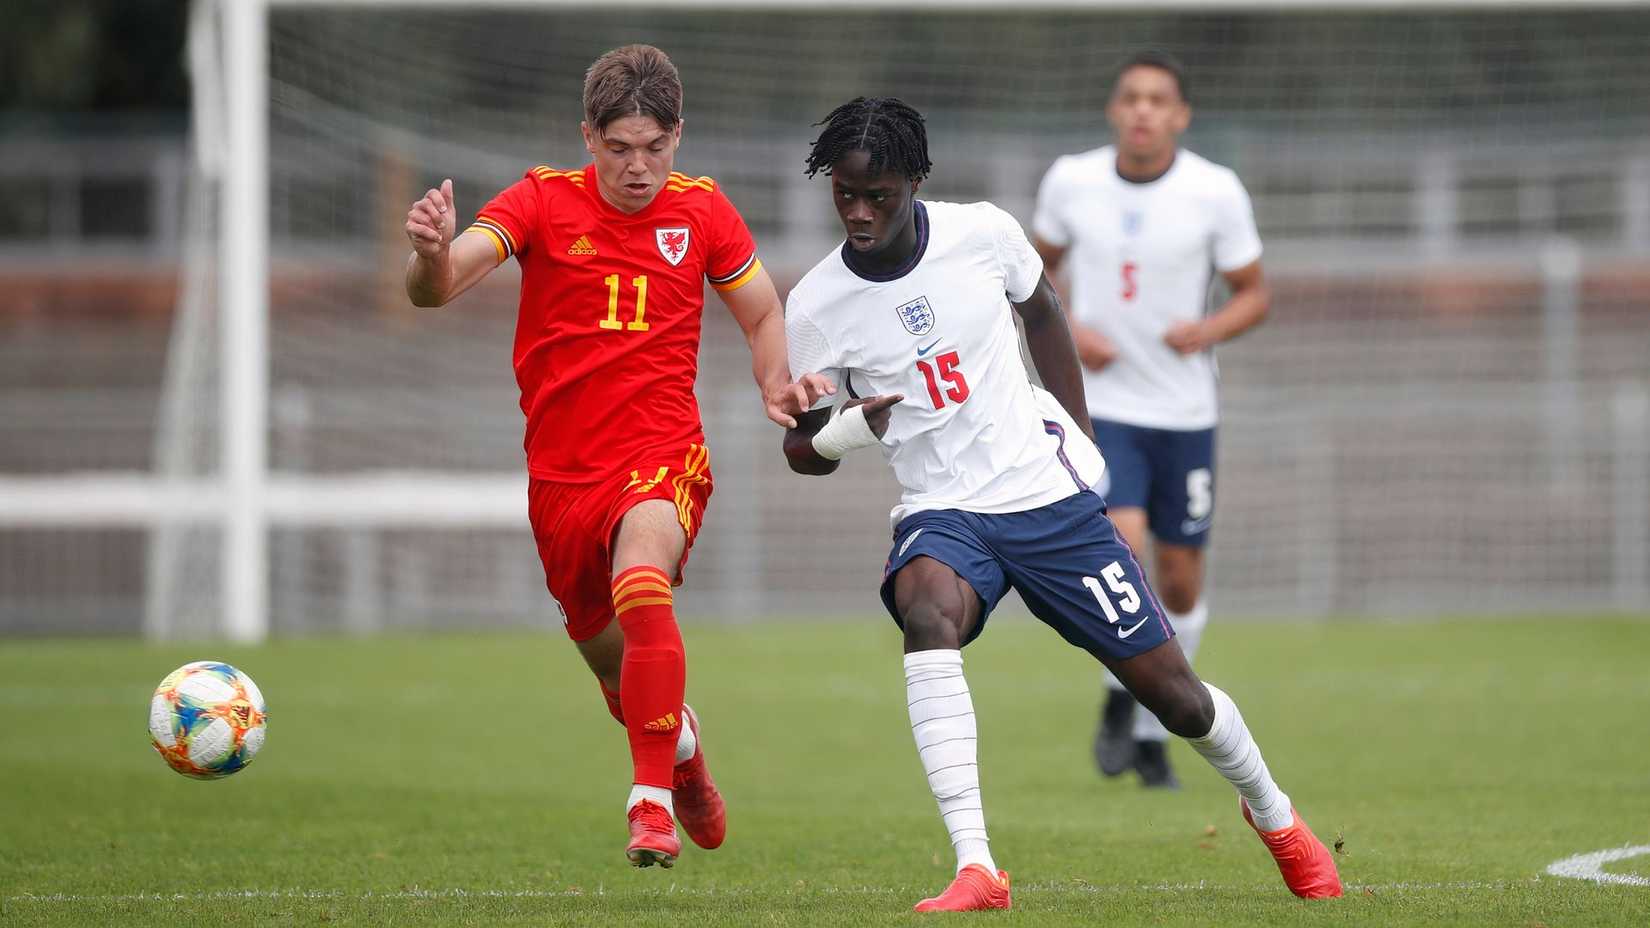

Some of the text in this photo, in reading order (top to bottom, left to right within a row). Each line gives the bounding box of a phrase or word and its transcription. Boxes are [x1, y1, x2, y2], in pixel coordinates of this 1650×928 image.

[568, 248, 597, 256] adidas
[599, 274, 649, 331] 11
[1119, 261, 1139, 301] 5
[916, 351, 970, 410] 15
[1186, 468, 1212, 518] 5
[1082, 561, 1141, 624] 15
